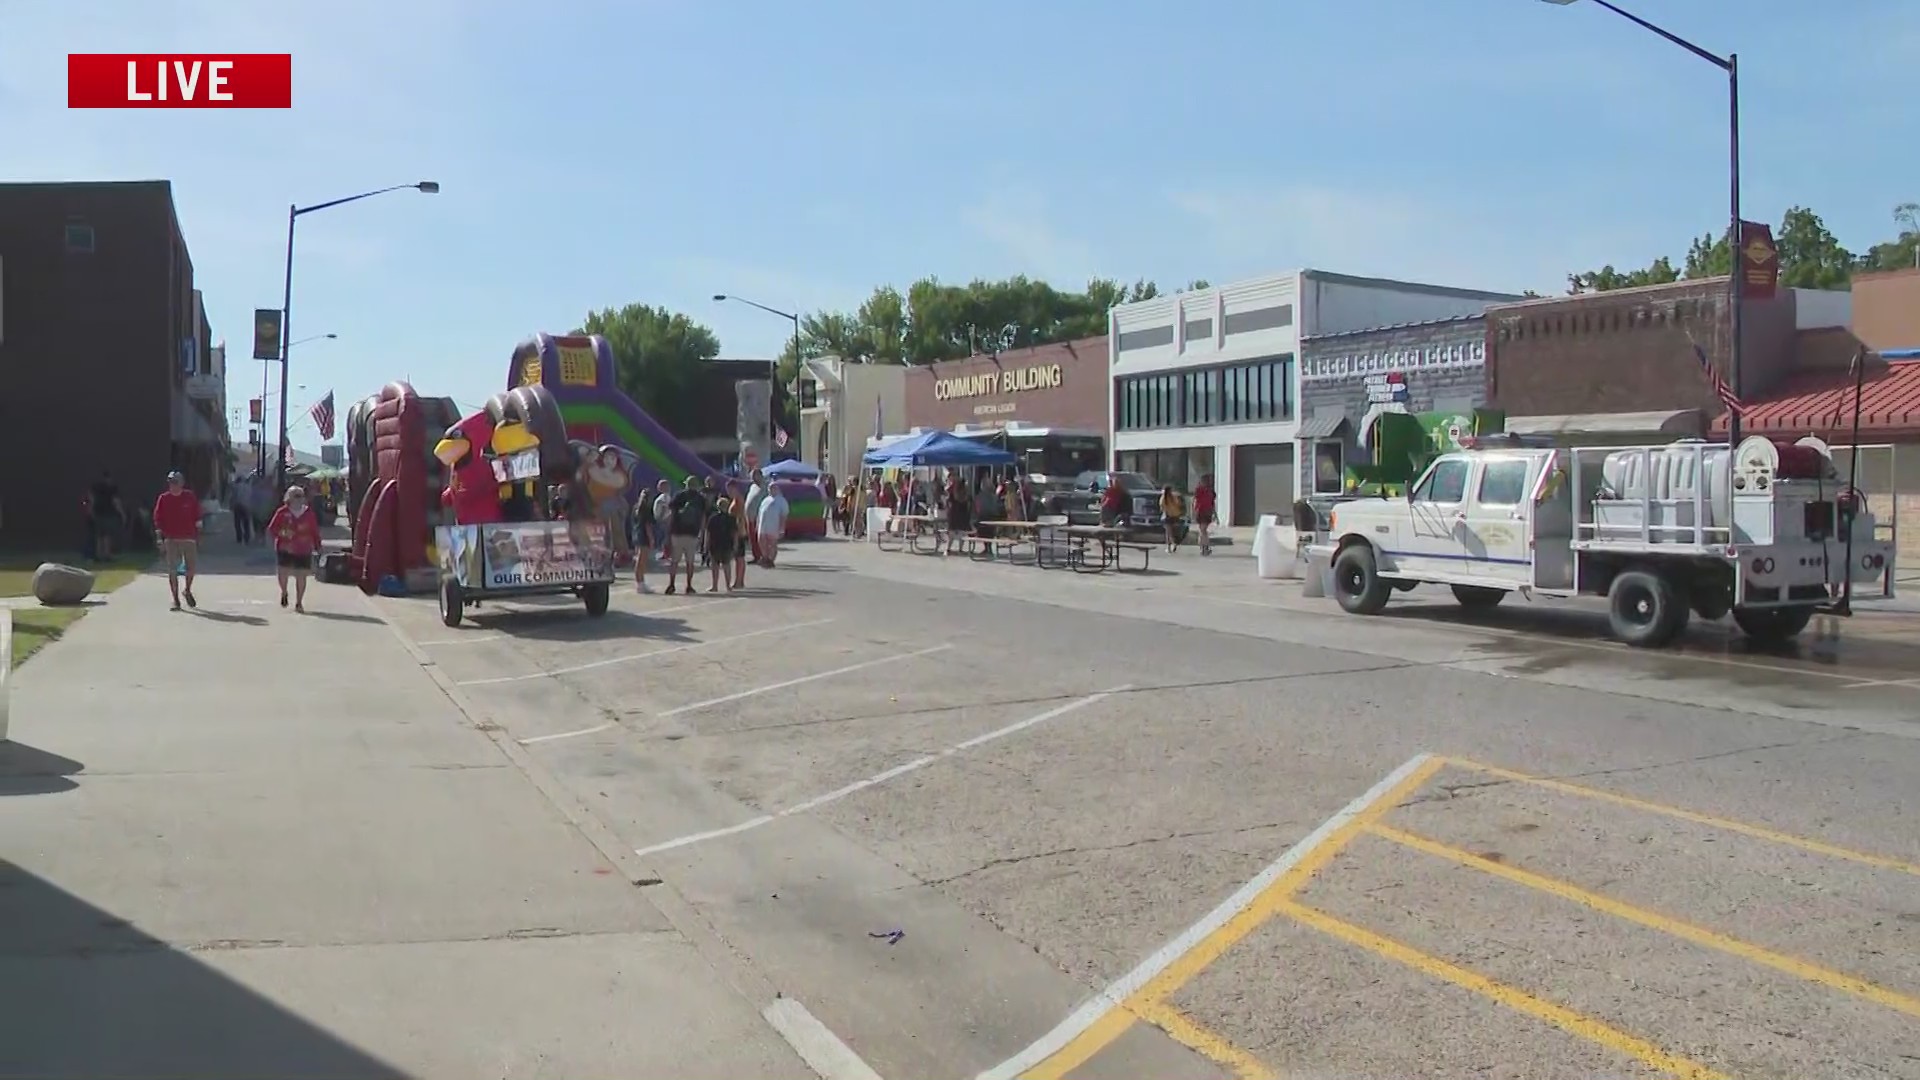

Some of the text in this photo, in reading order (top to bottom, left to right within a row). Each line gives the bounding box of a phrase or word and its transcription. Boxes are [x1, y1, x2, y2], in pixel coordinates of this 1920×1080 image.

[935, 364, 1061, 400] COMMUNITY BUILDING
[493, 569, 603, 584] OUR COMMUNITY
